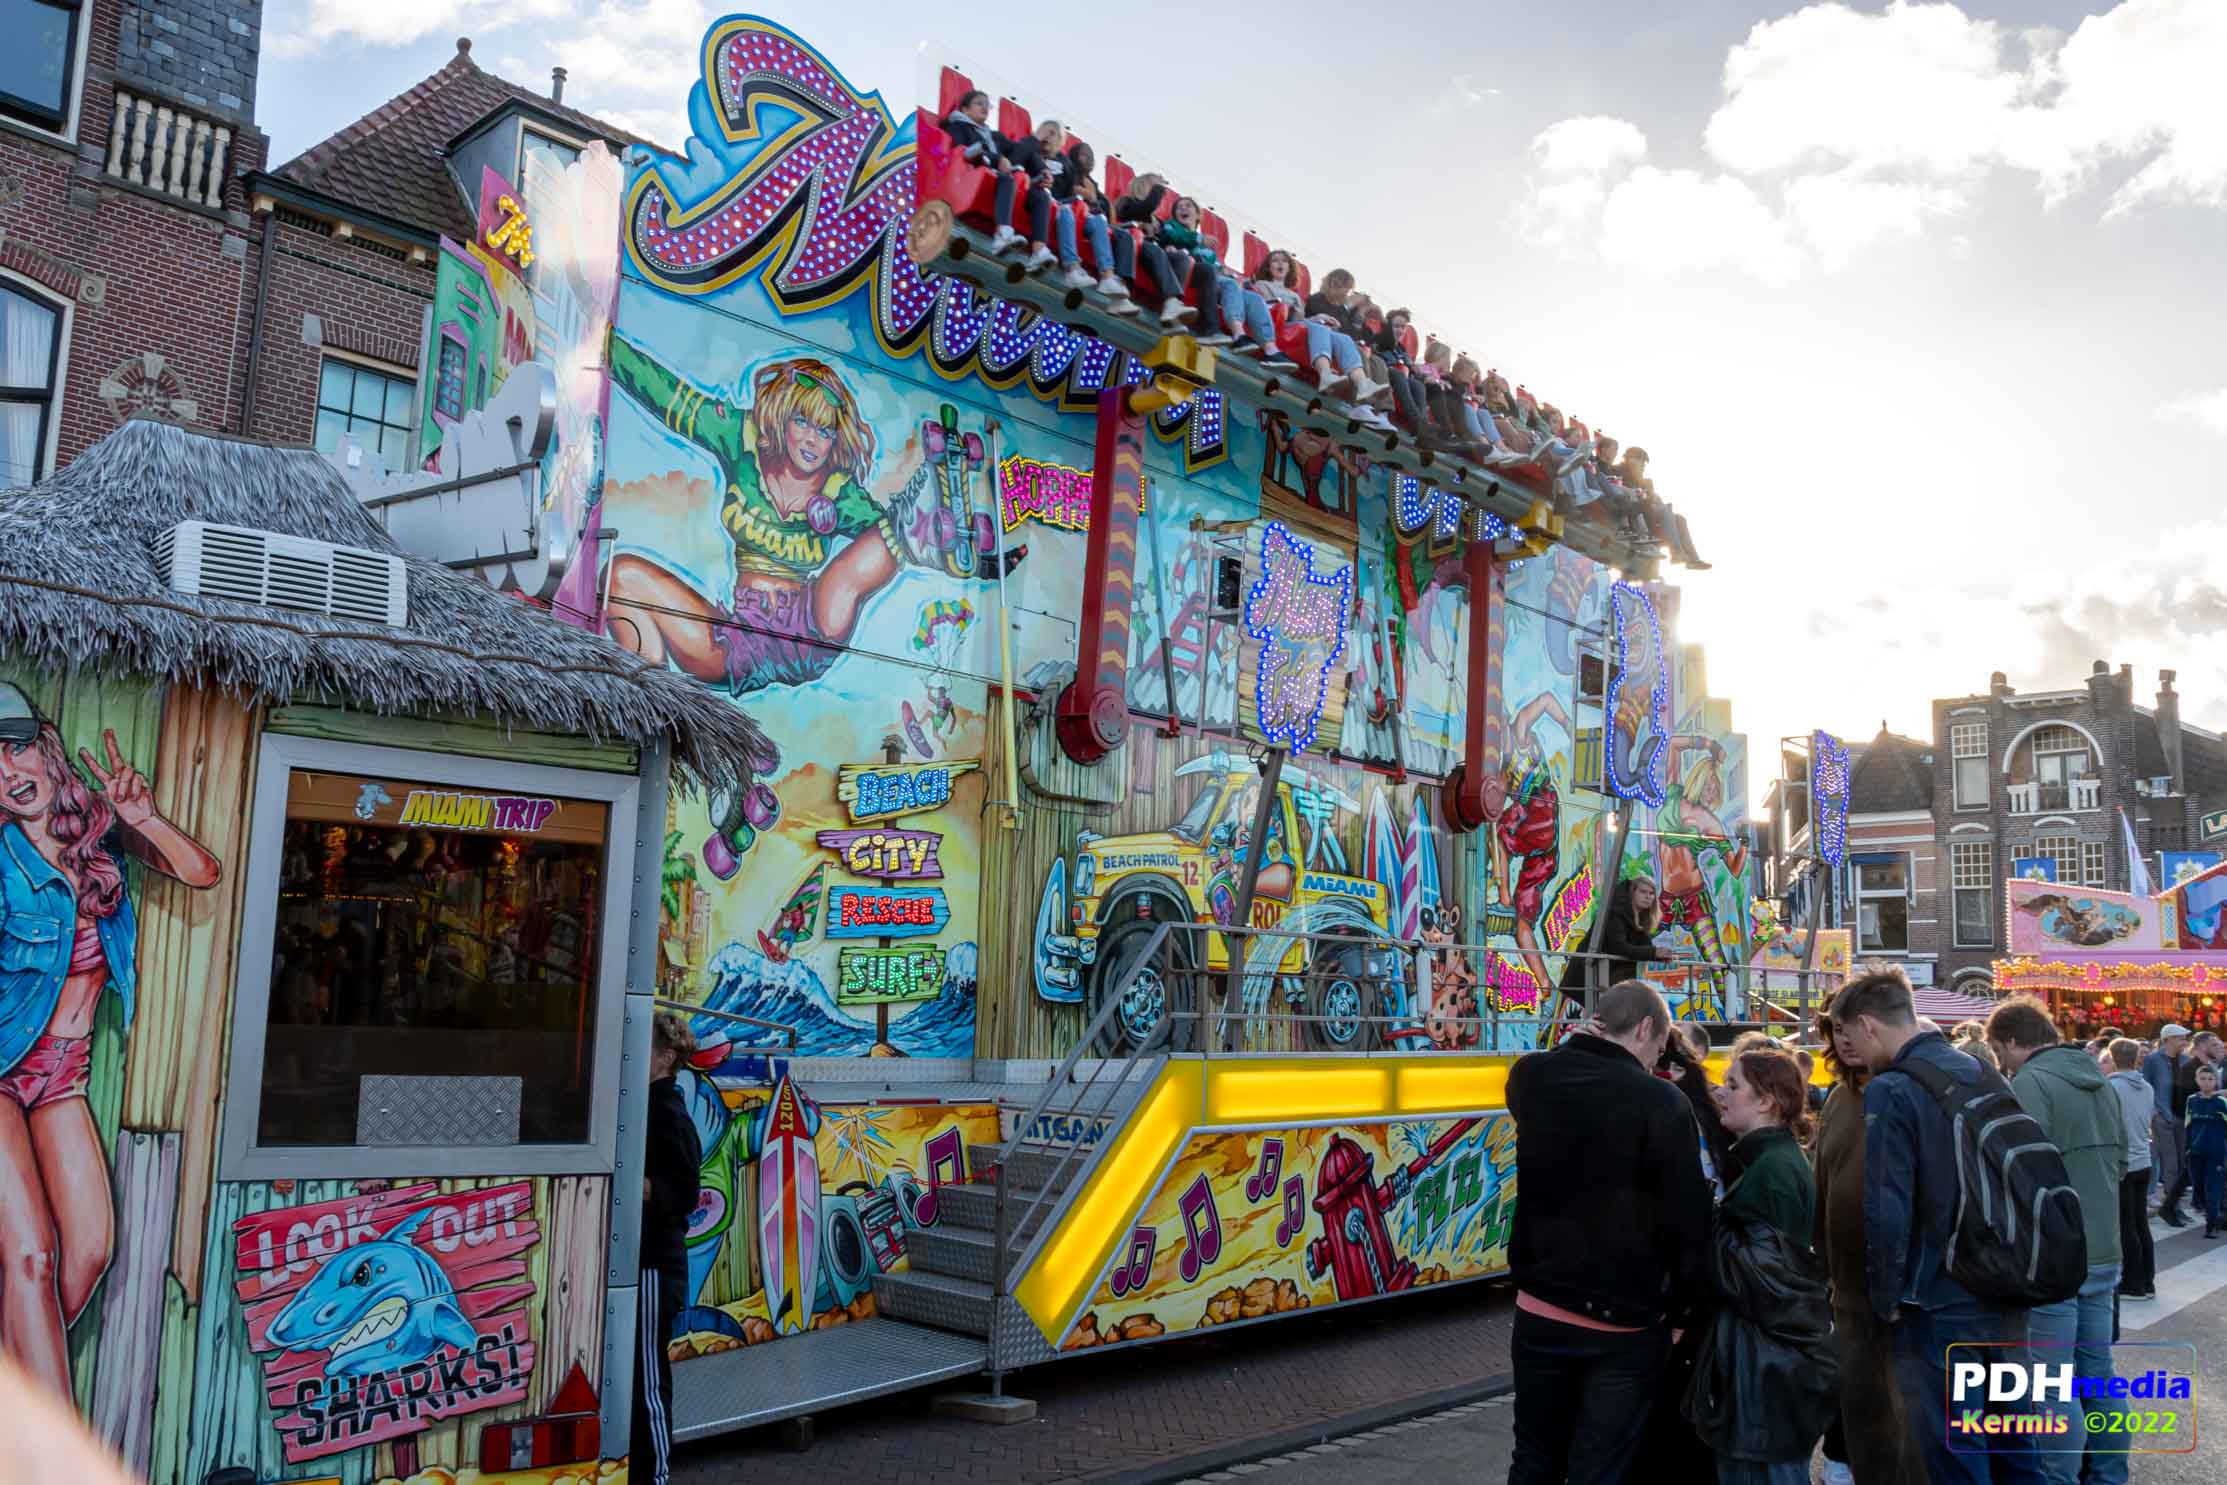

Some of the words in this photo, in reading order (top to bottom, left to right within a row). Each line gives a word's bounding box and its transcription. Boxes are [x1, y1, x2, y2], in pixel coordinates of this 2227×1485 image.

[400, 791, 493, 830] MIAMI
[494, 797, 557, 832] TRIP
[855, 768, 950, 817] BEACH
[1182, 861, 1199, 886] 12
[840, 893, 935, 926] RESCUE
[847, 953, 924, 998] SURF
[1013, 1113, 1113, 1144] ITGAN
[258, 1196, 382, 1287] LOOK
[432, 1192, 523, 1253] OUT
[294, 1324, 522, 1446] SHARKS!
